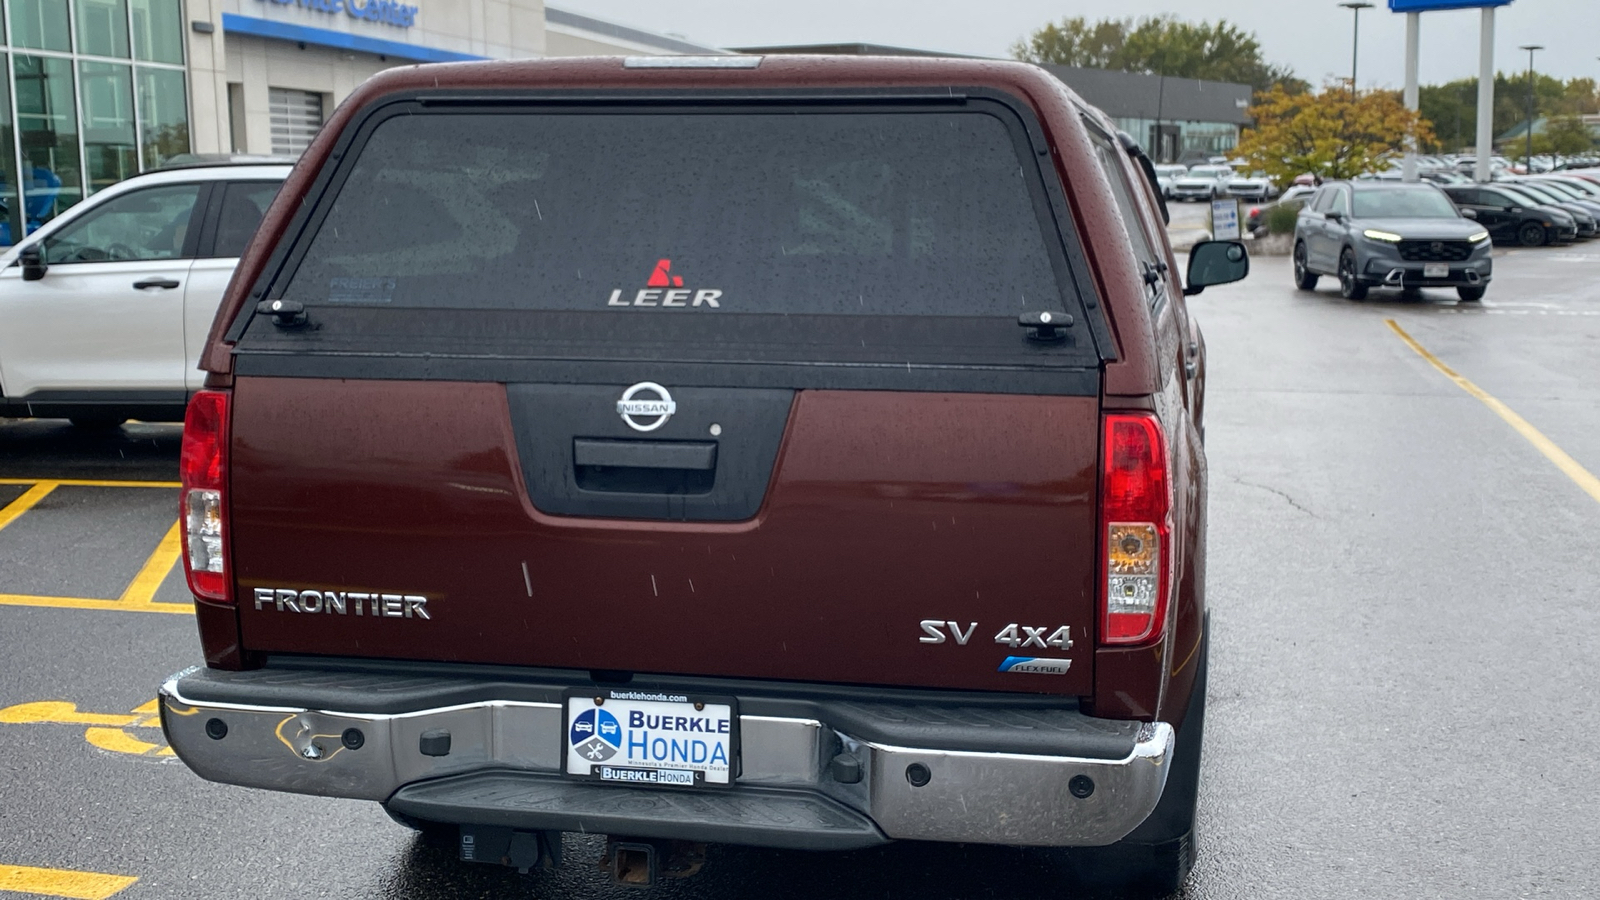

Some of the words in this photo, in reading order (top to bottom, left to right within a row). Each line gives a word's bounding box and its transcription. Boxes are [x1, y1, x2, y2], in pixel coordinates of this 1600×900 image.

[608, 289, 723, 308] LEER
[622, 404, 669, 412] NISSAN
[253, 587, 431, 620] FRONTIER
[919, 620, 978, 646] SV
[610, 691, 688, 702] buerklehonda.com
[629, 710, 729, 734] BUERKLE
[628, 730, 728, 765] HONDA
[602, 767, 657, 782] BUERKLE
[659, 771, 692, 784] HONDA
